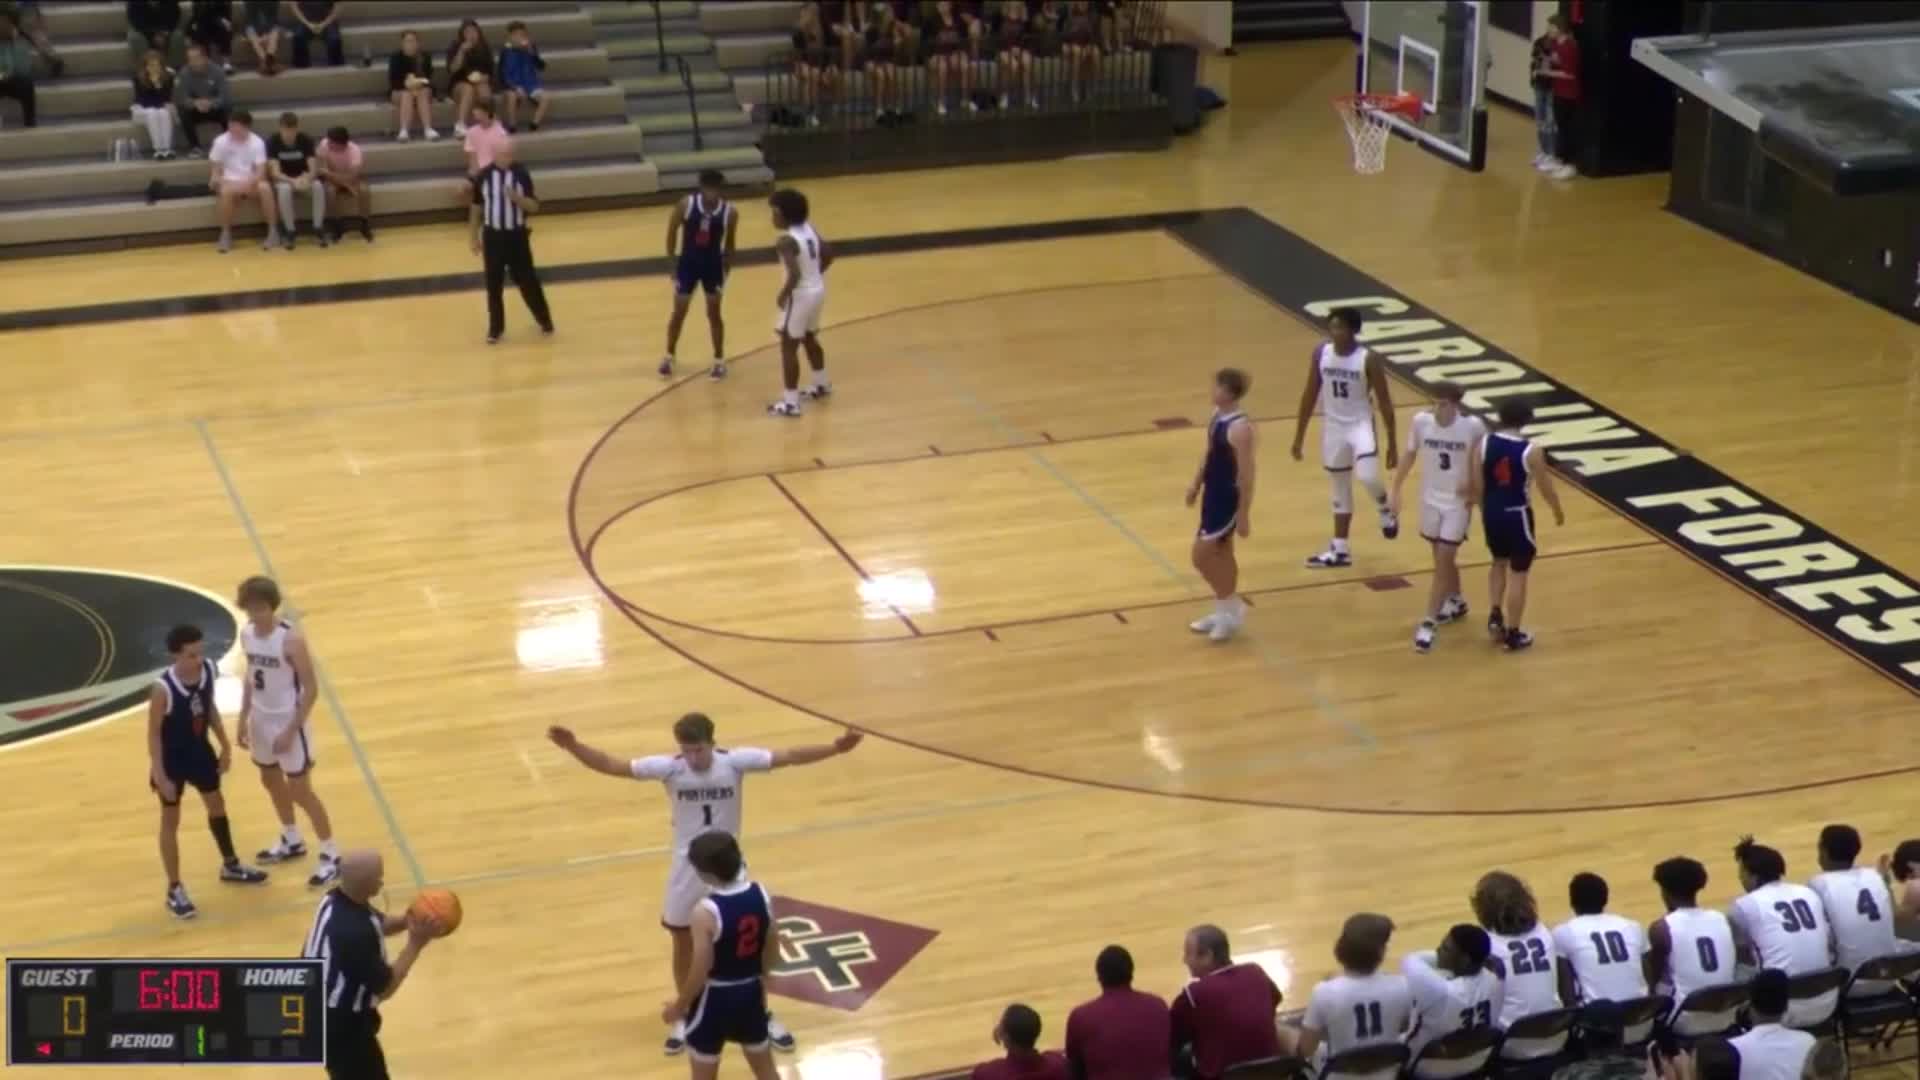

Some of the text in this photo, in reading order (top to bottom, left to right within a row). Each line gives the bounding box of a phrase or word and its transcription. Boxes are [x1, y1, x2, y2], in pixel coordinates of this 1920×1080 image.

[1332, 380, 1349, 399] 15
[1439, 452, 1451, 470] 3
[1494, 456, 1513, 485] 4
[1303, 297, 1920, 677] CAROLINA FORES
[254, 669, 265, 690] 5
[677, 786, 735, 801] PANTHERS
[702, 804, 713, 826] 1
[1774, 898, 1816, 933] 30
[1857, 888, 1880, 922] 4
[736, 914, 761, 959] 2
[1590, 930, 1629, 965] 10
[1507, 937, 1551, 975] 22
[1696, 936, 1719, 973] 0
[1354, 1001, 1382, 1039] 11
